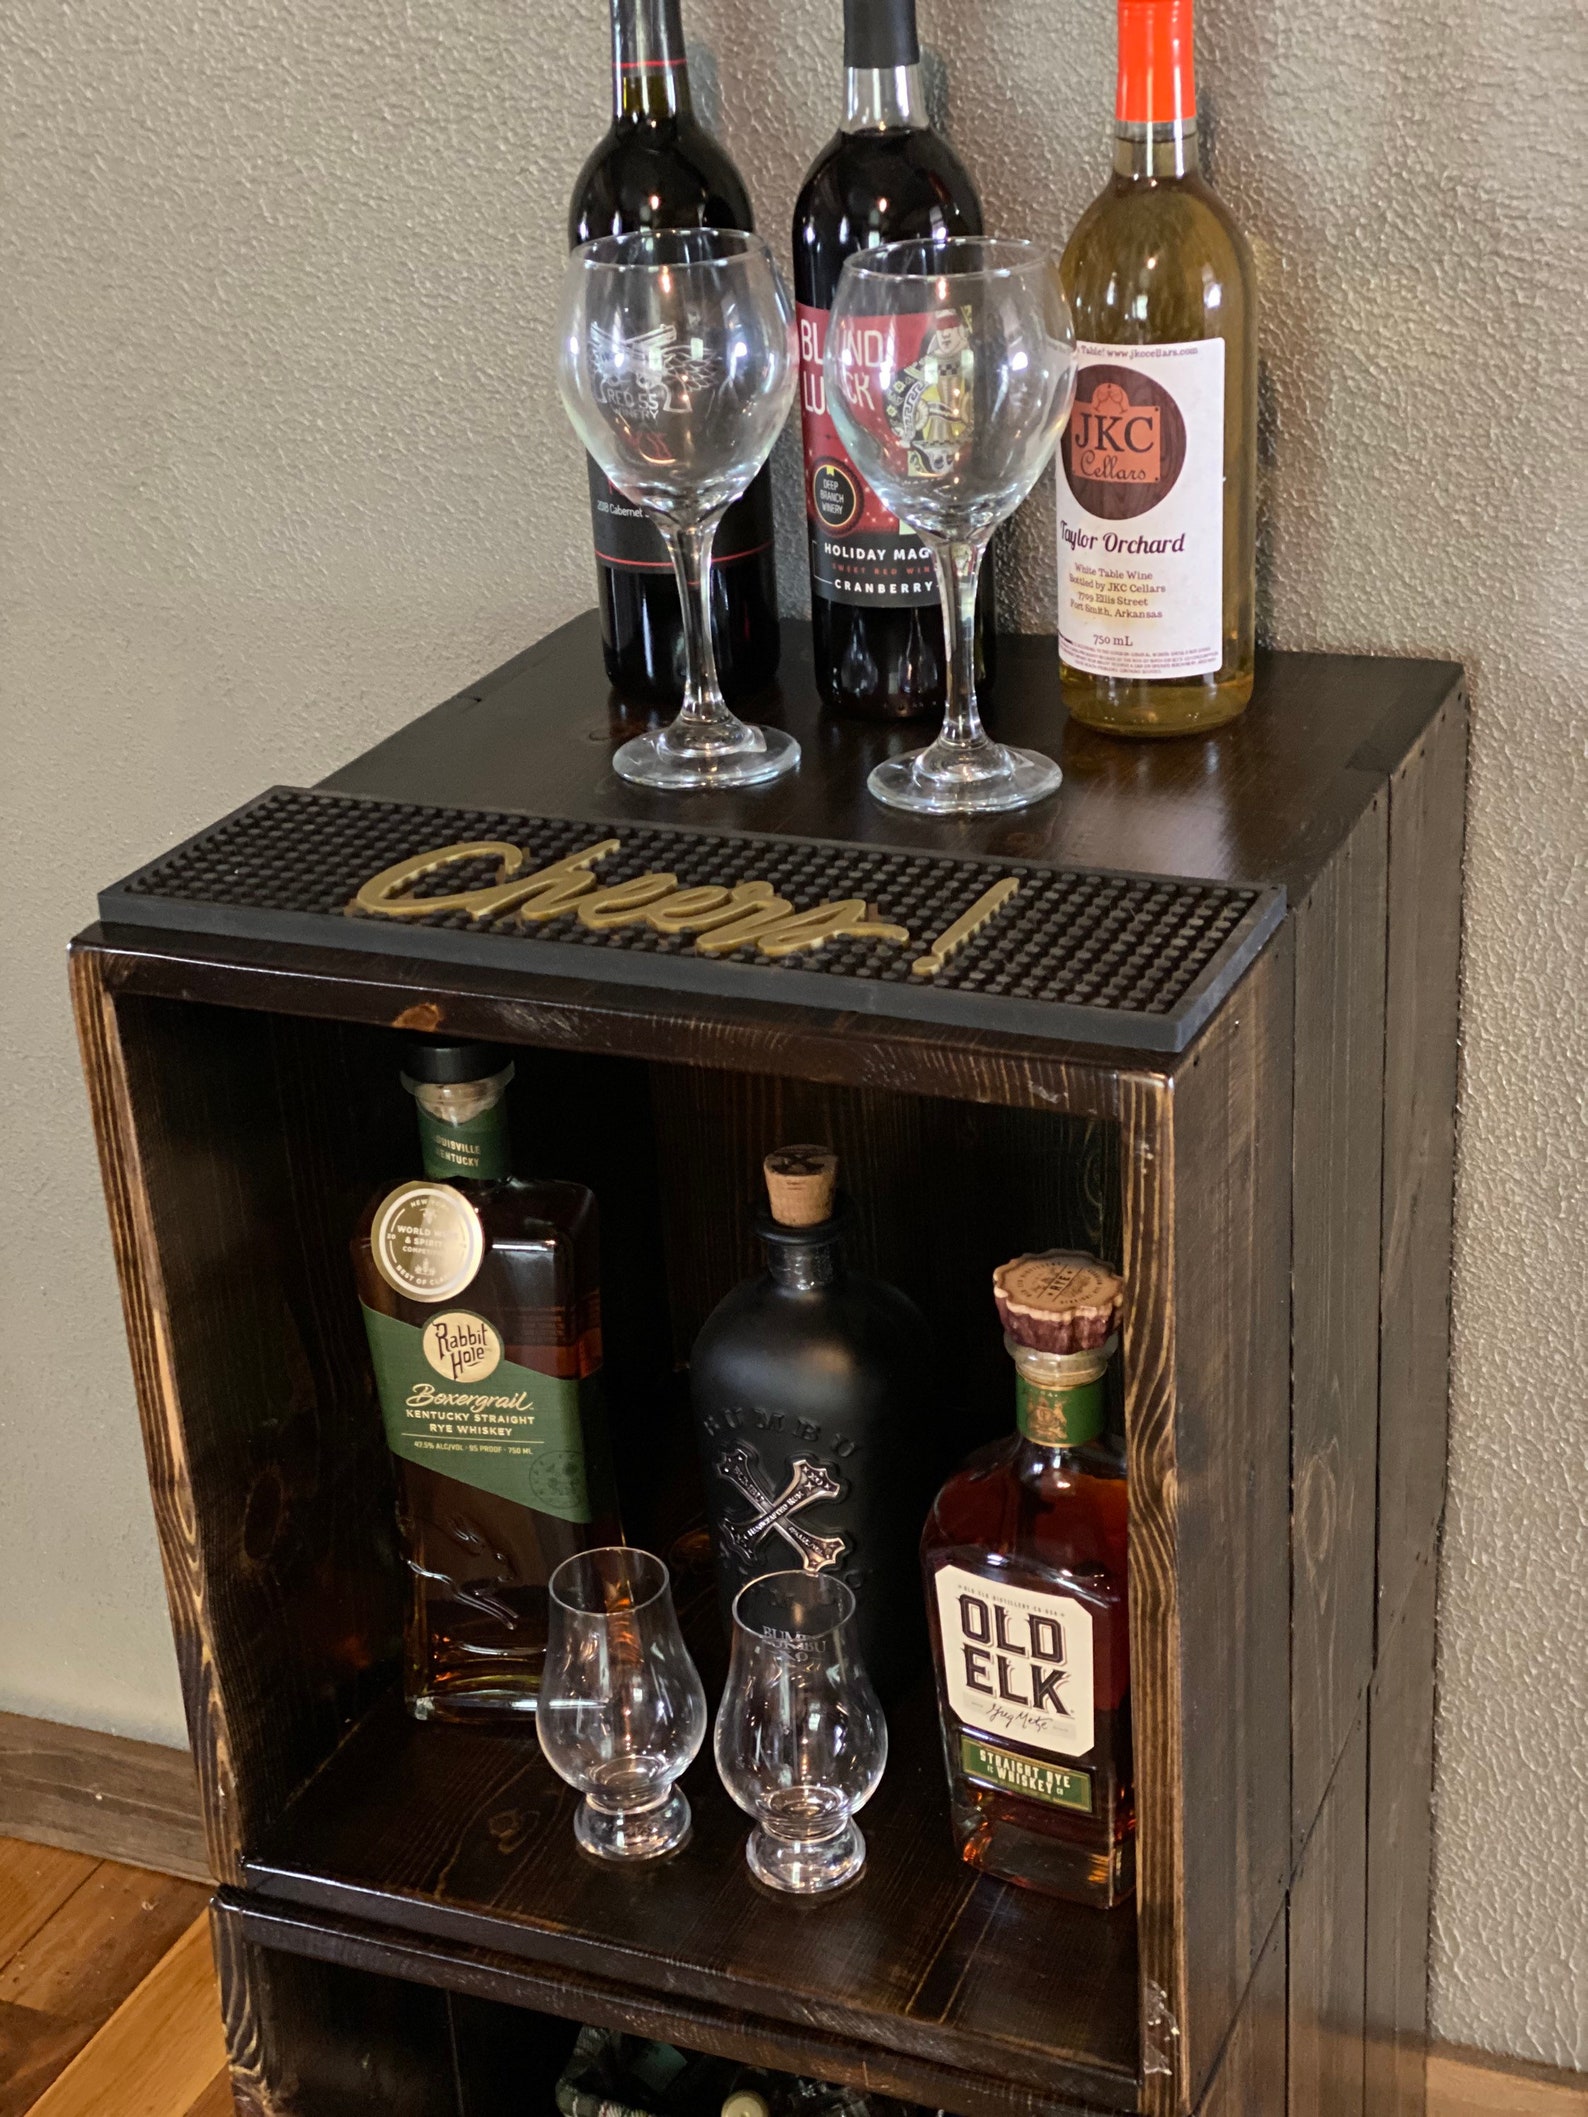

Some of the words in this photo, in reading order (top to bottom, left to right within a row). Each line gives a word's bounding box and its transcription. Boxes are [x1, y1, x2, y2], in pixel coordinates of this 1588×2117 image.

[1075, 413, 1154, 453] JKC
[1080, 449, 1146, 480] Cellars
[823, 479, 839, 491] DEEP
[820, 490, 844, 503] BRANCH
[610, 503, 643, 518] Cabernet
[822, 502, 843, 515] WINERY
[1060, 519, 1098, 551] Taylor
[1103, 531, 1186, 554] Orchard
[824, 542, 886, 561] HOLIDAY
[894, 546, 932, 561] MAG
[1075, 562, 1097, 576] White
[1099, 567, 1124, 579] Table
[1127, 570, 1153, 580] Wine
[834, 579, 933, 595] CRANBERRY
[1069, 573, 1094, 589] Bottled
[1096, 581, 1106, 593] by
[1107, 582, 1127, 593] JKC
[1129, 584, 1166, 593] Cellars
[1070, 599, 1084, 611] Fort
[1115, 608, 1163, 619] Arkansas
[1096, 594, 1115, 605] Ellis
[1117, 596, 1149, 607] Street
[1093, 634, 1111, 646] 750
[1113, 636, 1133, 647] mL
[410, 1198, 428, 1208] NEW
[397, 1225, 431, 1237] WORLD
[404, 1236, 412, 1244] &
[395, 1264, 415, 1281] BEST
[1049, 1275, 1070, 1291] RYE
[432, 1322, 488, 1360] Rabbit
[450, 1347, 485, 1380] Hole
[405, 1383, 533, 1413] Boxergrail
[406, 1409, 470, 1422] KENTUCKY
[474, 1413, 535, 1425] STRAIGHT
[429, 1423, 453, 1433] RYE
[457, 1425, 513, 1437] WHISKEY
[480, 1445, 502, 1453] PROOF
[508, 1447, 521, 1455] 750
[957, 1593, 1067, 1664] OLD
[961, 1643, 1075, 1718] ELK
[980, 1749, 1039, 1779] STRAIGHT
[1047, 1770, 1071, 1788] RYE
[996, 1767, 1053, 1794] WHISKEY
